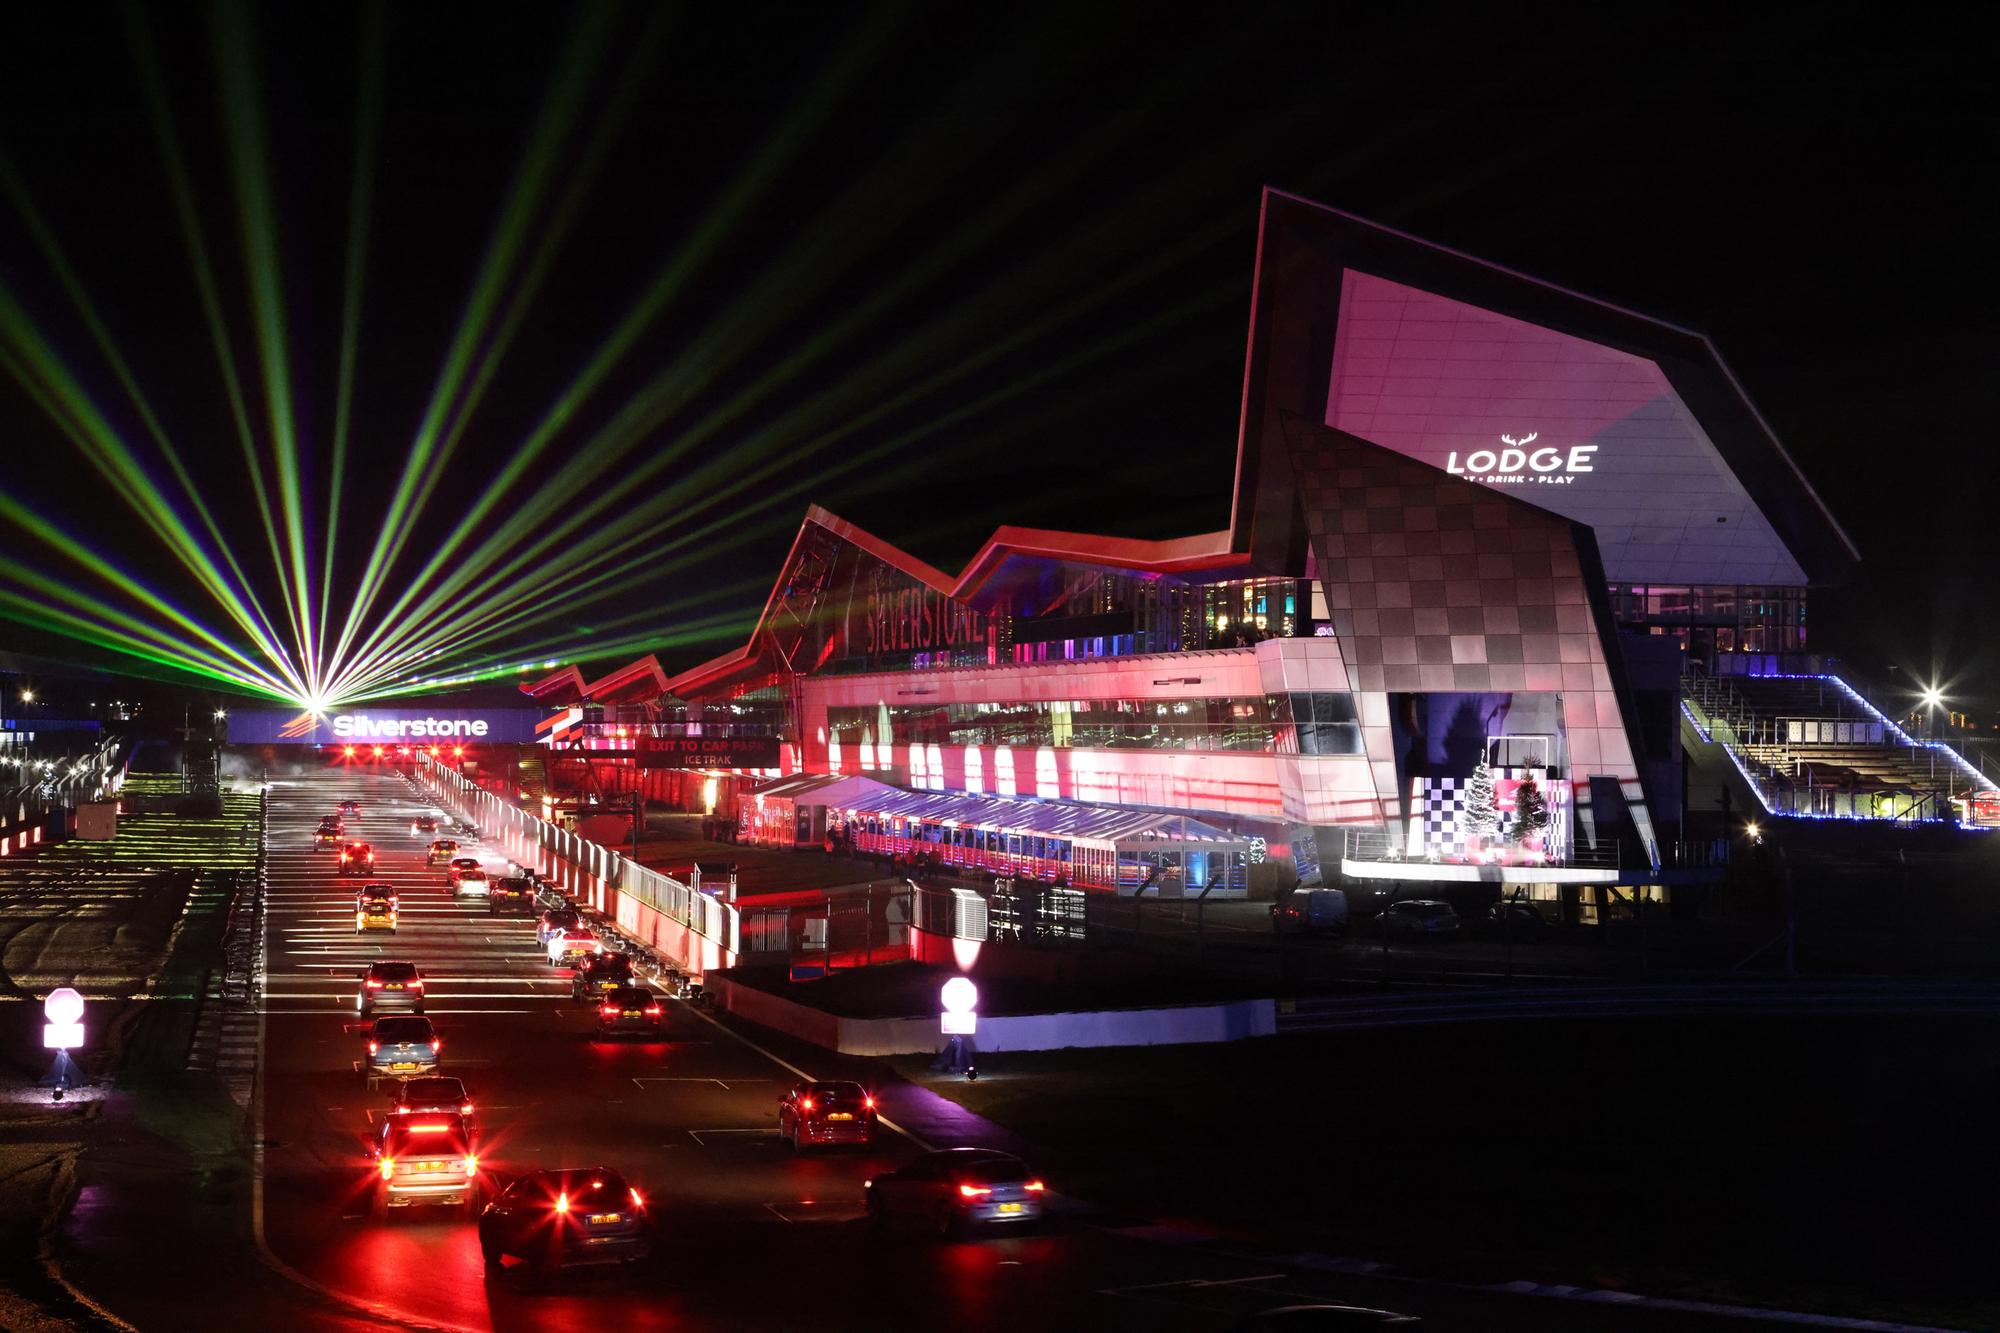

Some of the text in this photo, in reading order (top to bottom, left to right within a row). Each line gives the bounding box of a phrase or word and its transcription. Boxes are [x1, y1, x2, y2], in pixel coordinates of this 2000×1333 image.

[1447, 445, 1598, 473] LODGE
[1487, 475, 1575, 485] DRINK PLAY
[333, 715, 489, 737] Silverstone
[649, 740, 675, 752] EXIT
[680, 740, 699, 752] TO
[685, 755, 732, 765] ICE TRAK
